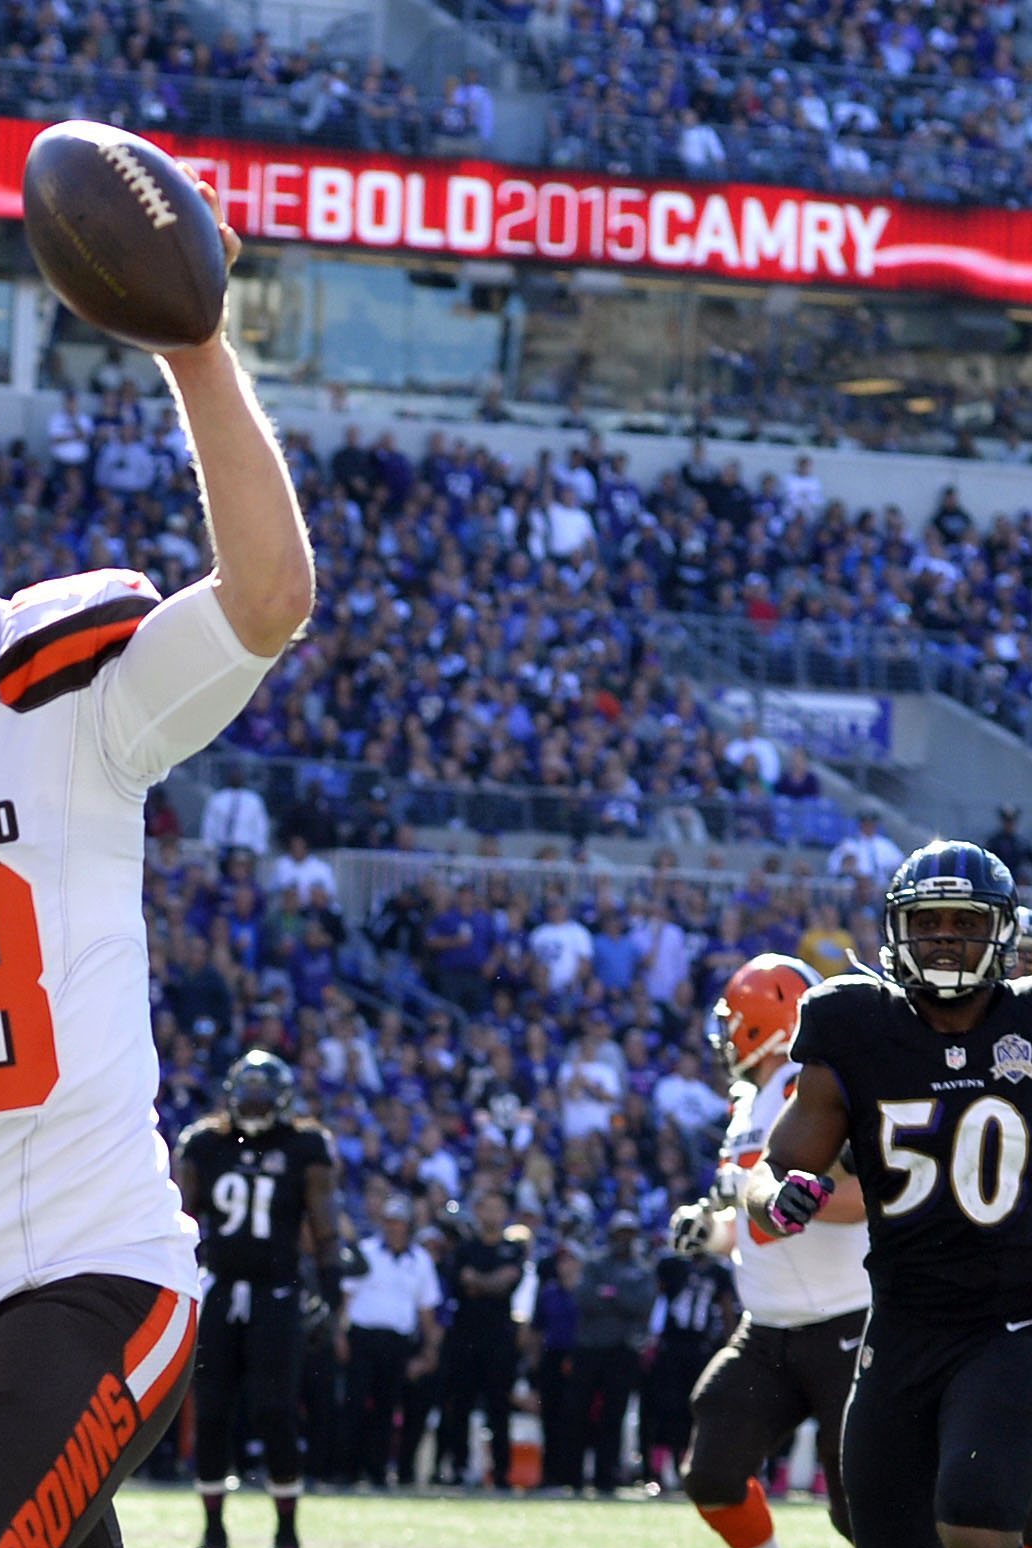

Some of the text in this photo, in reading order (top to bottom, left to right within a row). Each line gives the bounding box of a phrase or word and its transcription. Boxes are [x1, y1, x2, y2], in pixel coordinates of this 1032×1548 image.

[930, 1079, 985, 1092] RAVENS
[877, 1094, 1030, 1228] 50
[212, 1171, 276, 1239] 91
